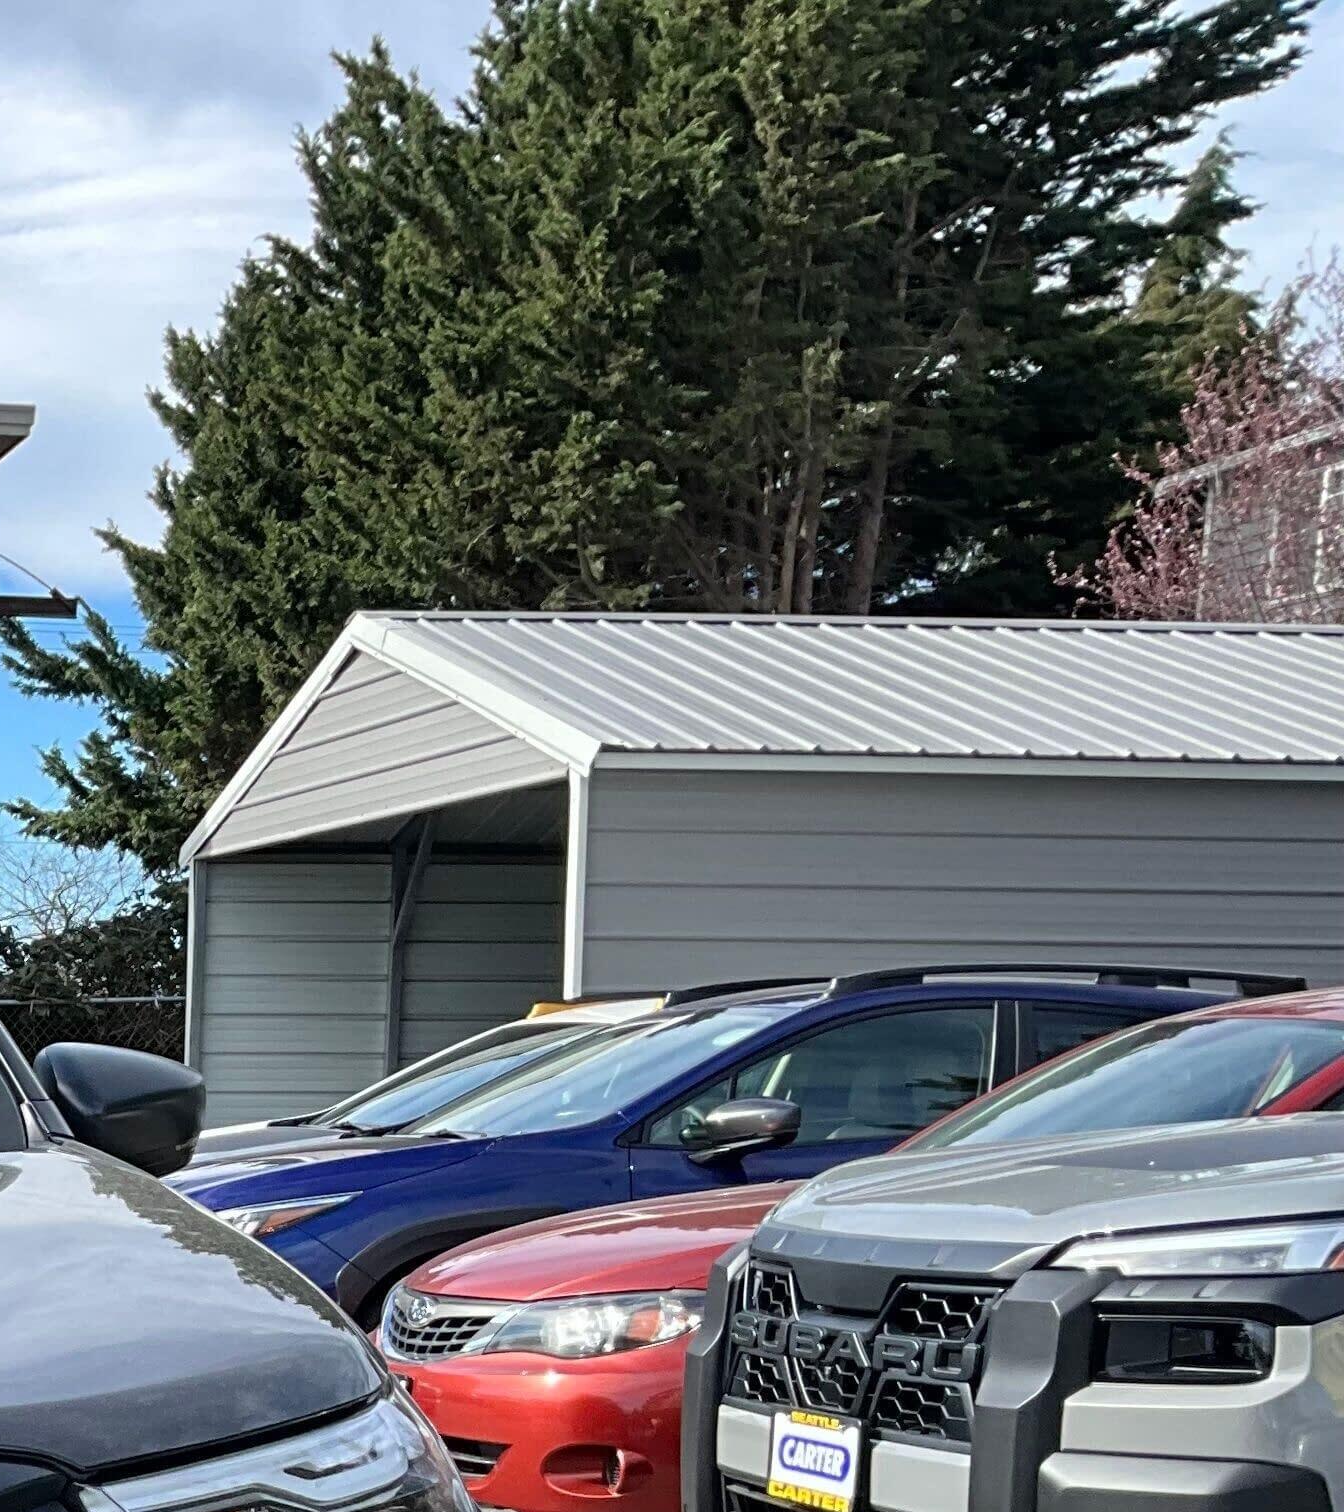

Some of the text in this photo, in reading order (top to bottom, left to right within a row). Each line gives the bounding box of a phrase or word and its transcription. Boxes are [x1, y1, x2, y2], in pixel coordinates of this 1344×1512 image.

[731, 1310, 978, 1383] SUBARU
[790, 1410, 840, 1430] SEATTLE
[782, 1437, 845, 1478] CARTER
